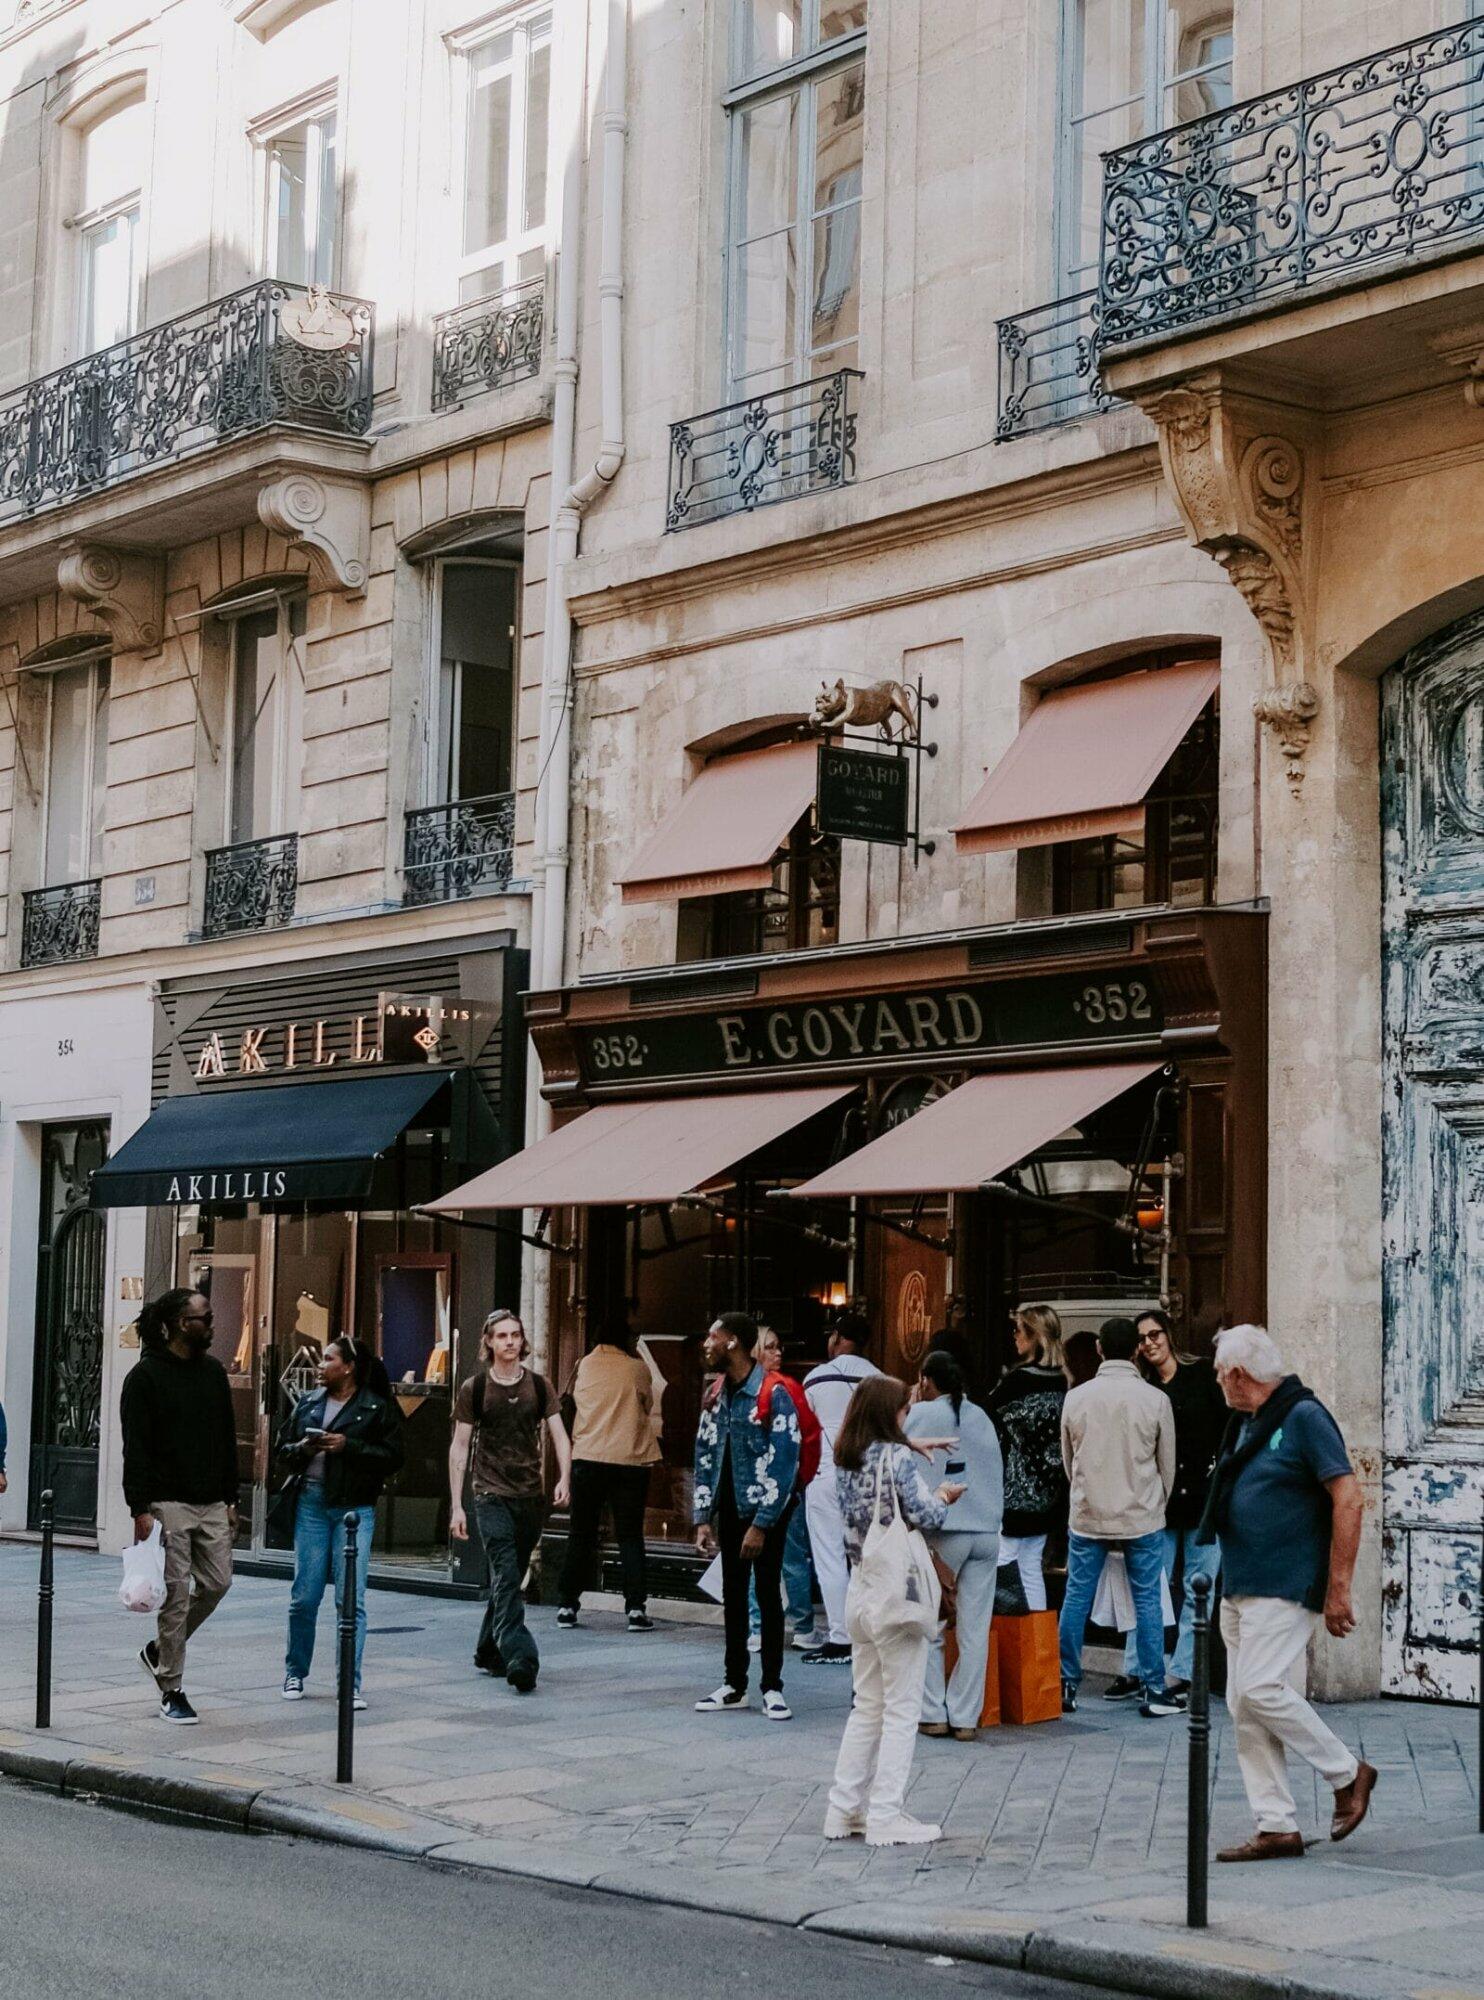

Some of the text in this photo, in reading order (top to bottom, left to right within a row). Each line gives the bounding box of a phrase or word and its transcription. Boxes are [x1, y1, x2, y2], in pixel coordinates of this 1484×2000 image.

[385, 1004, 471, 1021] AKILLIS
[58, 1039, 74, 1057] 354
[194, 1015, 379, 1078] AKILL
[166, 1171, 287, 1202] AKILLIS
